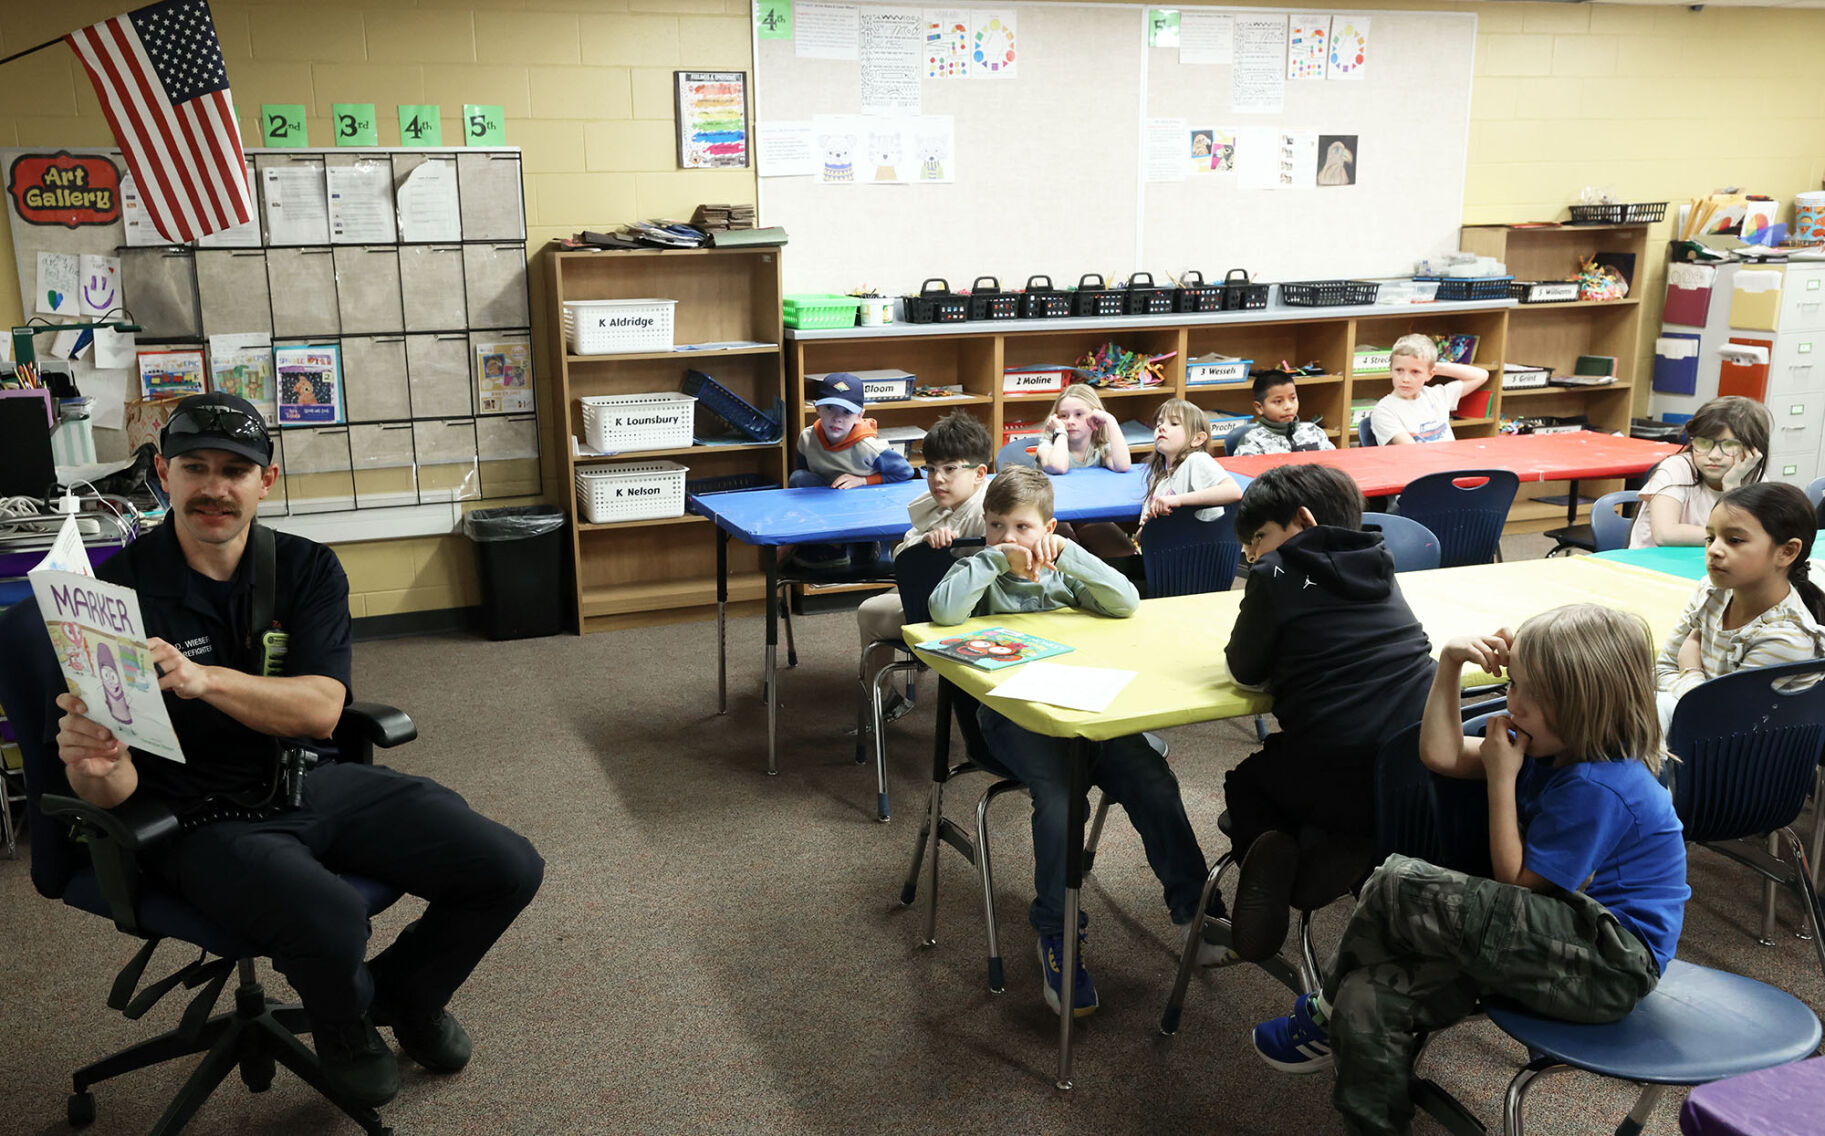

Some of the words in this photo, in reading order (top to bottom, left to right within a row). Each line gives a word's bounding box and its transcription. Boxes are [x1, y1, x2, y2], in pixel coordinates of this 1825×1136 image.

[761, 7, 786, 31] 4th
[268, 113, 301, 138] 2nd
[338, 113, 369, 137] 3rd
[404, 114, 432, 139] 4th
[469, 115, 497, 137] 5th
[44, 167, 85, 186] Art
[26, 188, 111, 209] Gallery
[599, 318, 606, 328] K
[609, 316, 654, 329] Aldridge
[1023, 375, 1052, 385] Moline
[1200, 367, 1206, 376] 3
[1209, 366, 1236, 375] Wessels
[864, 384, 894, 393] Bloom
[615, 417, 622, 427] K
[626, 415, 679, 426] Lounsbury
[616, 488, 623, 497] K
[627, 486, 661, 496] Nelson
[50, 584, 136, 636] MARKER
